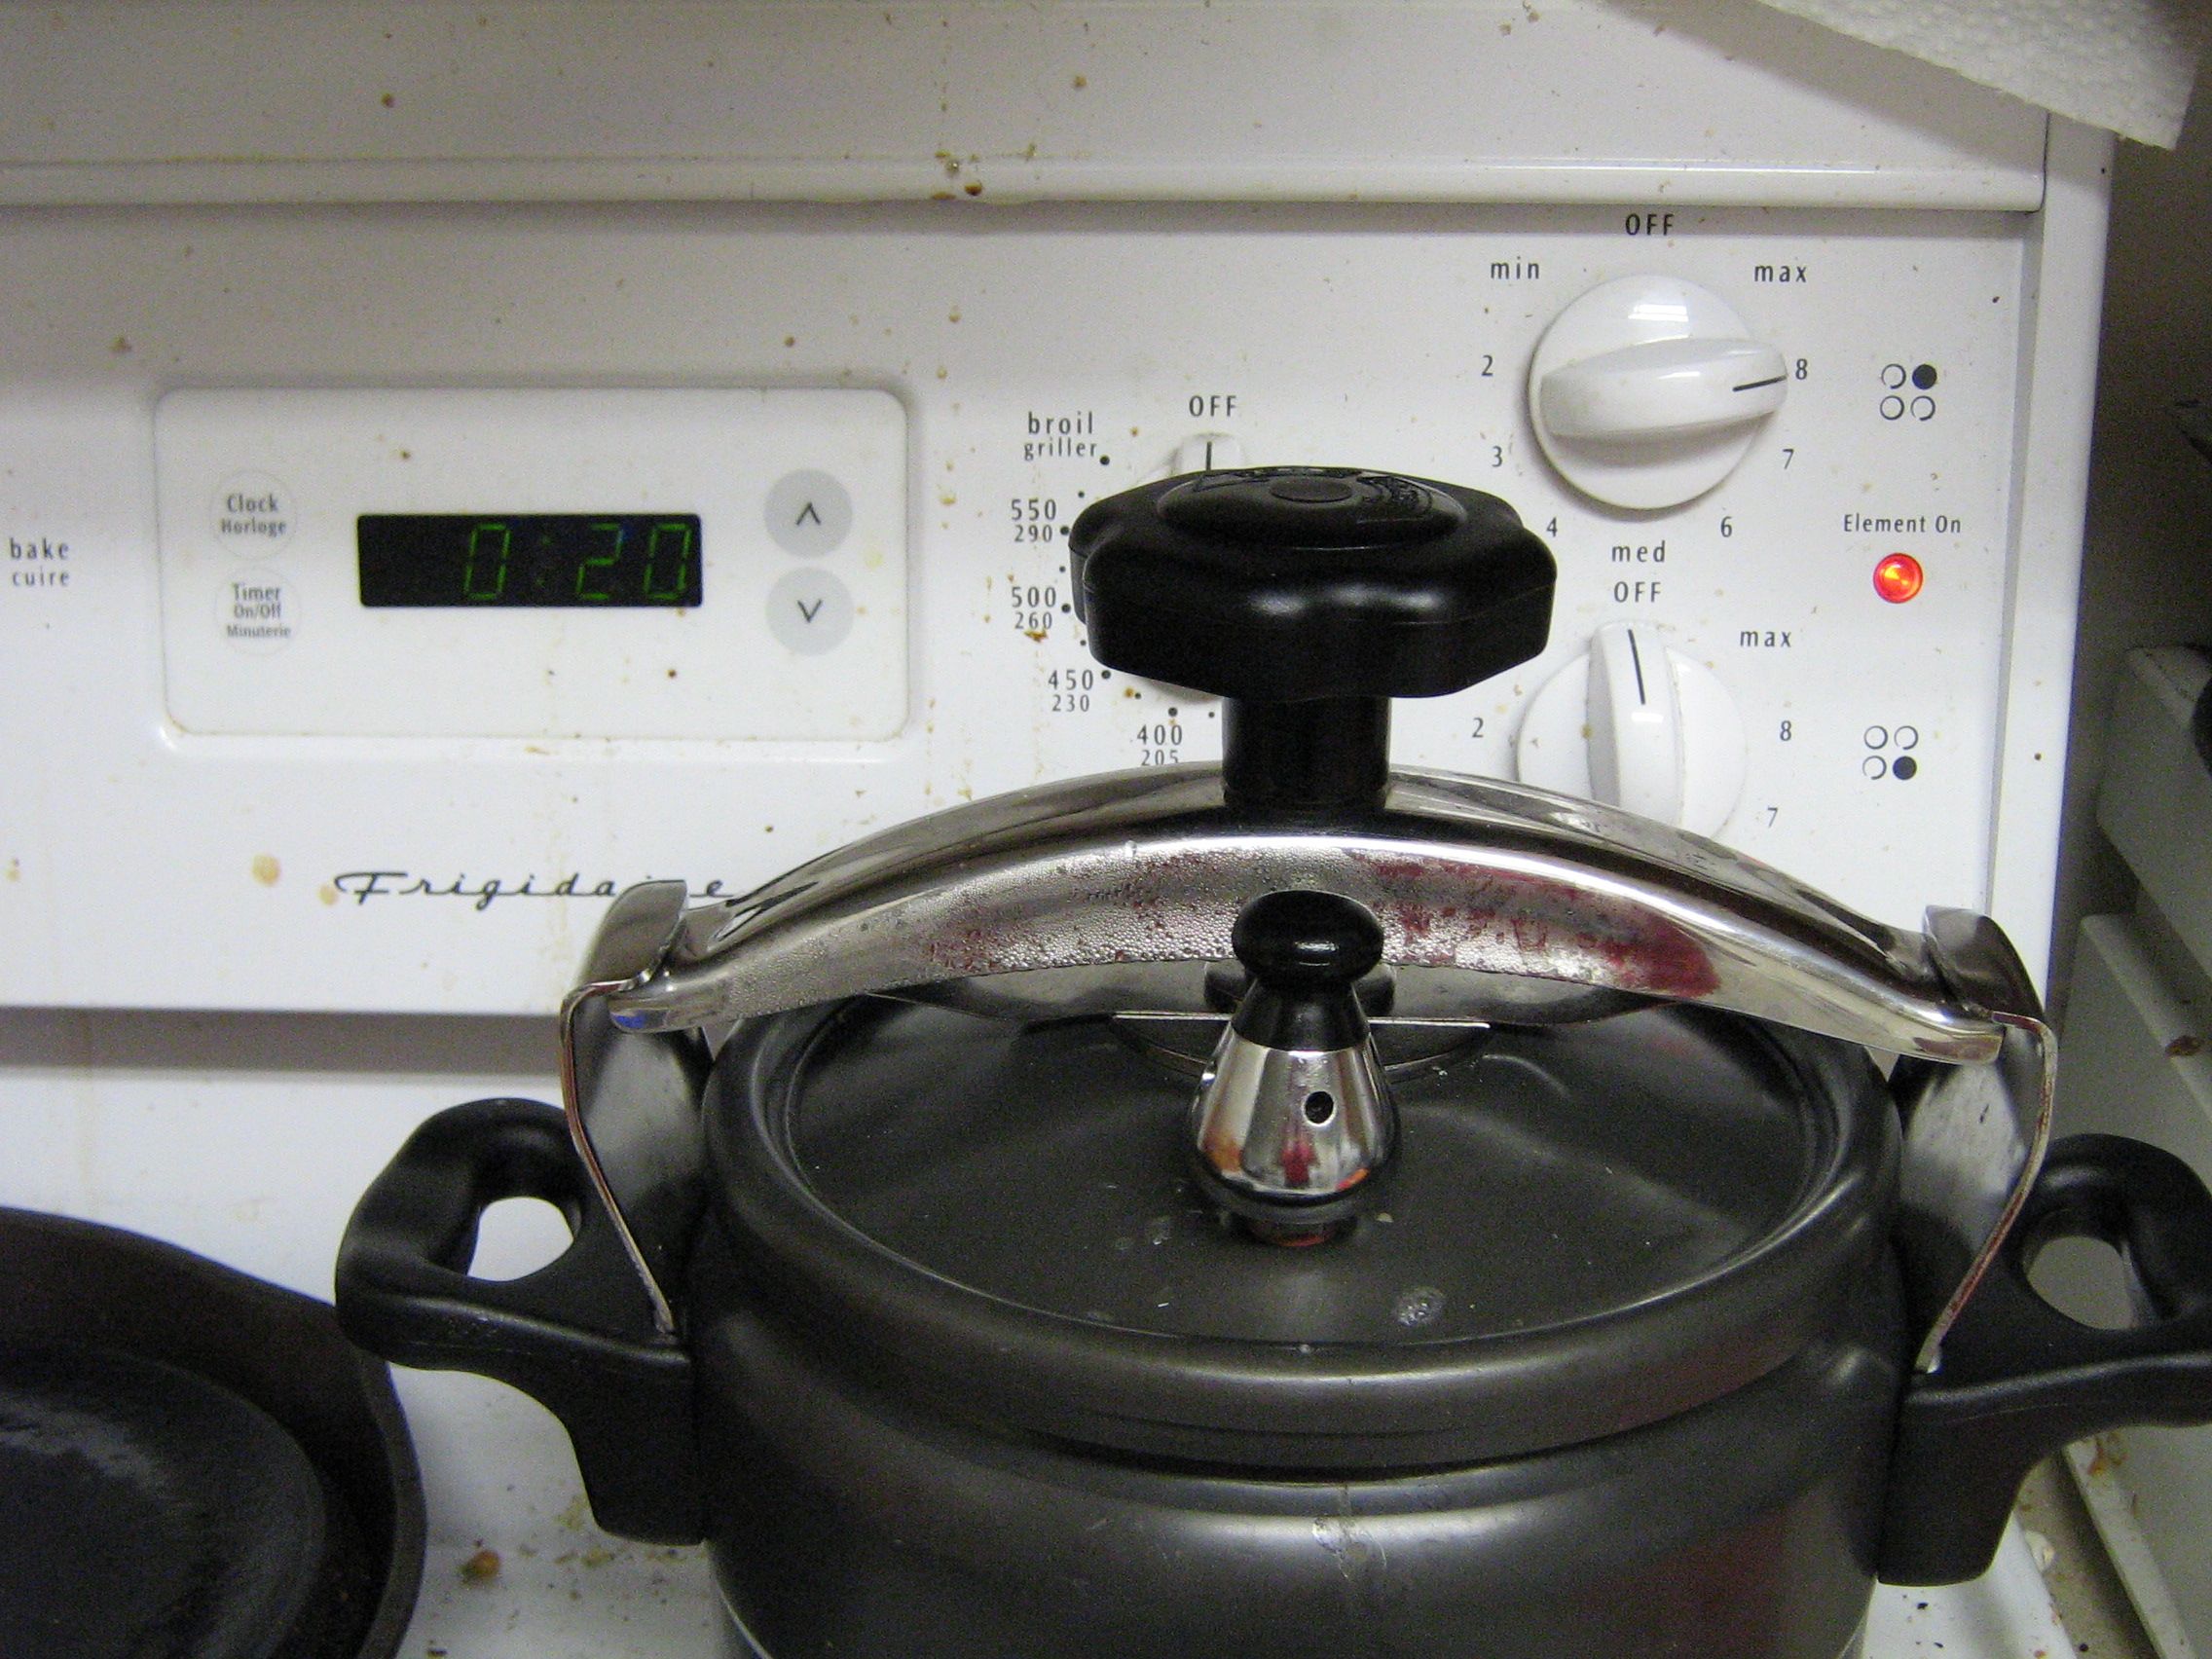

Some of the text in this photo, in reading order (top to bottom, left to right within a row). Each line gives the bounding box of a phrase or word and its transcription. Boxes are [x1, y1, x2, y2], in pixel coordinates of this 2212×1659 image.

[1625, 213, 1675, 237] OFF
[1491, 256, 1540, 279] min
[1754, 263, 1808, 283] max
[1481, 355, 1493, 376] 2
[1795, 358, 1809, 380] 8
[1189, 395, 1237, 416] OFF
[1028, 411, 1093, 435] broil
[1023, 437, 1098, 461] griller
[1493, 447, 1504, 468] 3
[1783, 450, 1794, 469] 7
[226, 495, 278, 513] Clock
[1011, 499, 1056, 520] 550
[221, 517, 286, 537] Horloge
[1014, 526, 1053, 542] 290
[1547, 517, 1558, 538] 4
[1720, 516, 1733, 538] 6
[1843, 514, 1961, 534] Element On
[11, 538, 69, 560] bake
[1611, 539, 1667, 564] med
[12, 568, 71, 586] cuire
[232, 583, 281, 601] Timer
[1012, 587, 1056, 608] 500
[1613, 581, 1663, 604] OFF
[234, 602, 281, 619] On/Off
[1015, 612, 1053, 630] 260
[227, 625, 291, 638] Minuterie
[1740, 629, 1792, 648] max
[1048, 669, 1093, 689] 450
[1052, 694, 1090, 712] 230
[1137, 724, 1183, 746] 400
[1472, 718, 1485, 739] 2
[1779, 720, 1793, 742] 8
[1141, 749, 1179, 766] 205
[1767, 807, 1778, 828] 7
[334, 871, 734, 911] Frigidae
